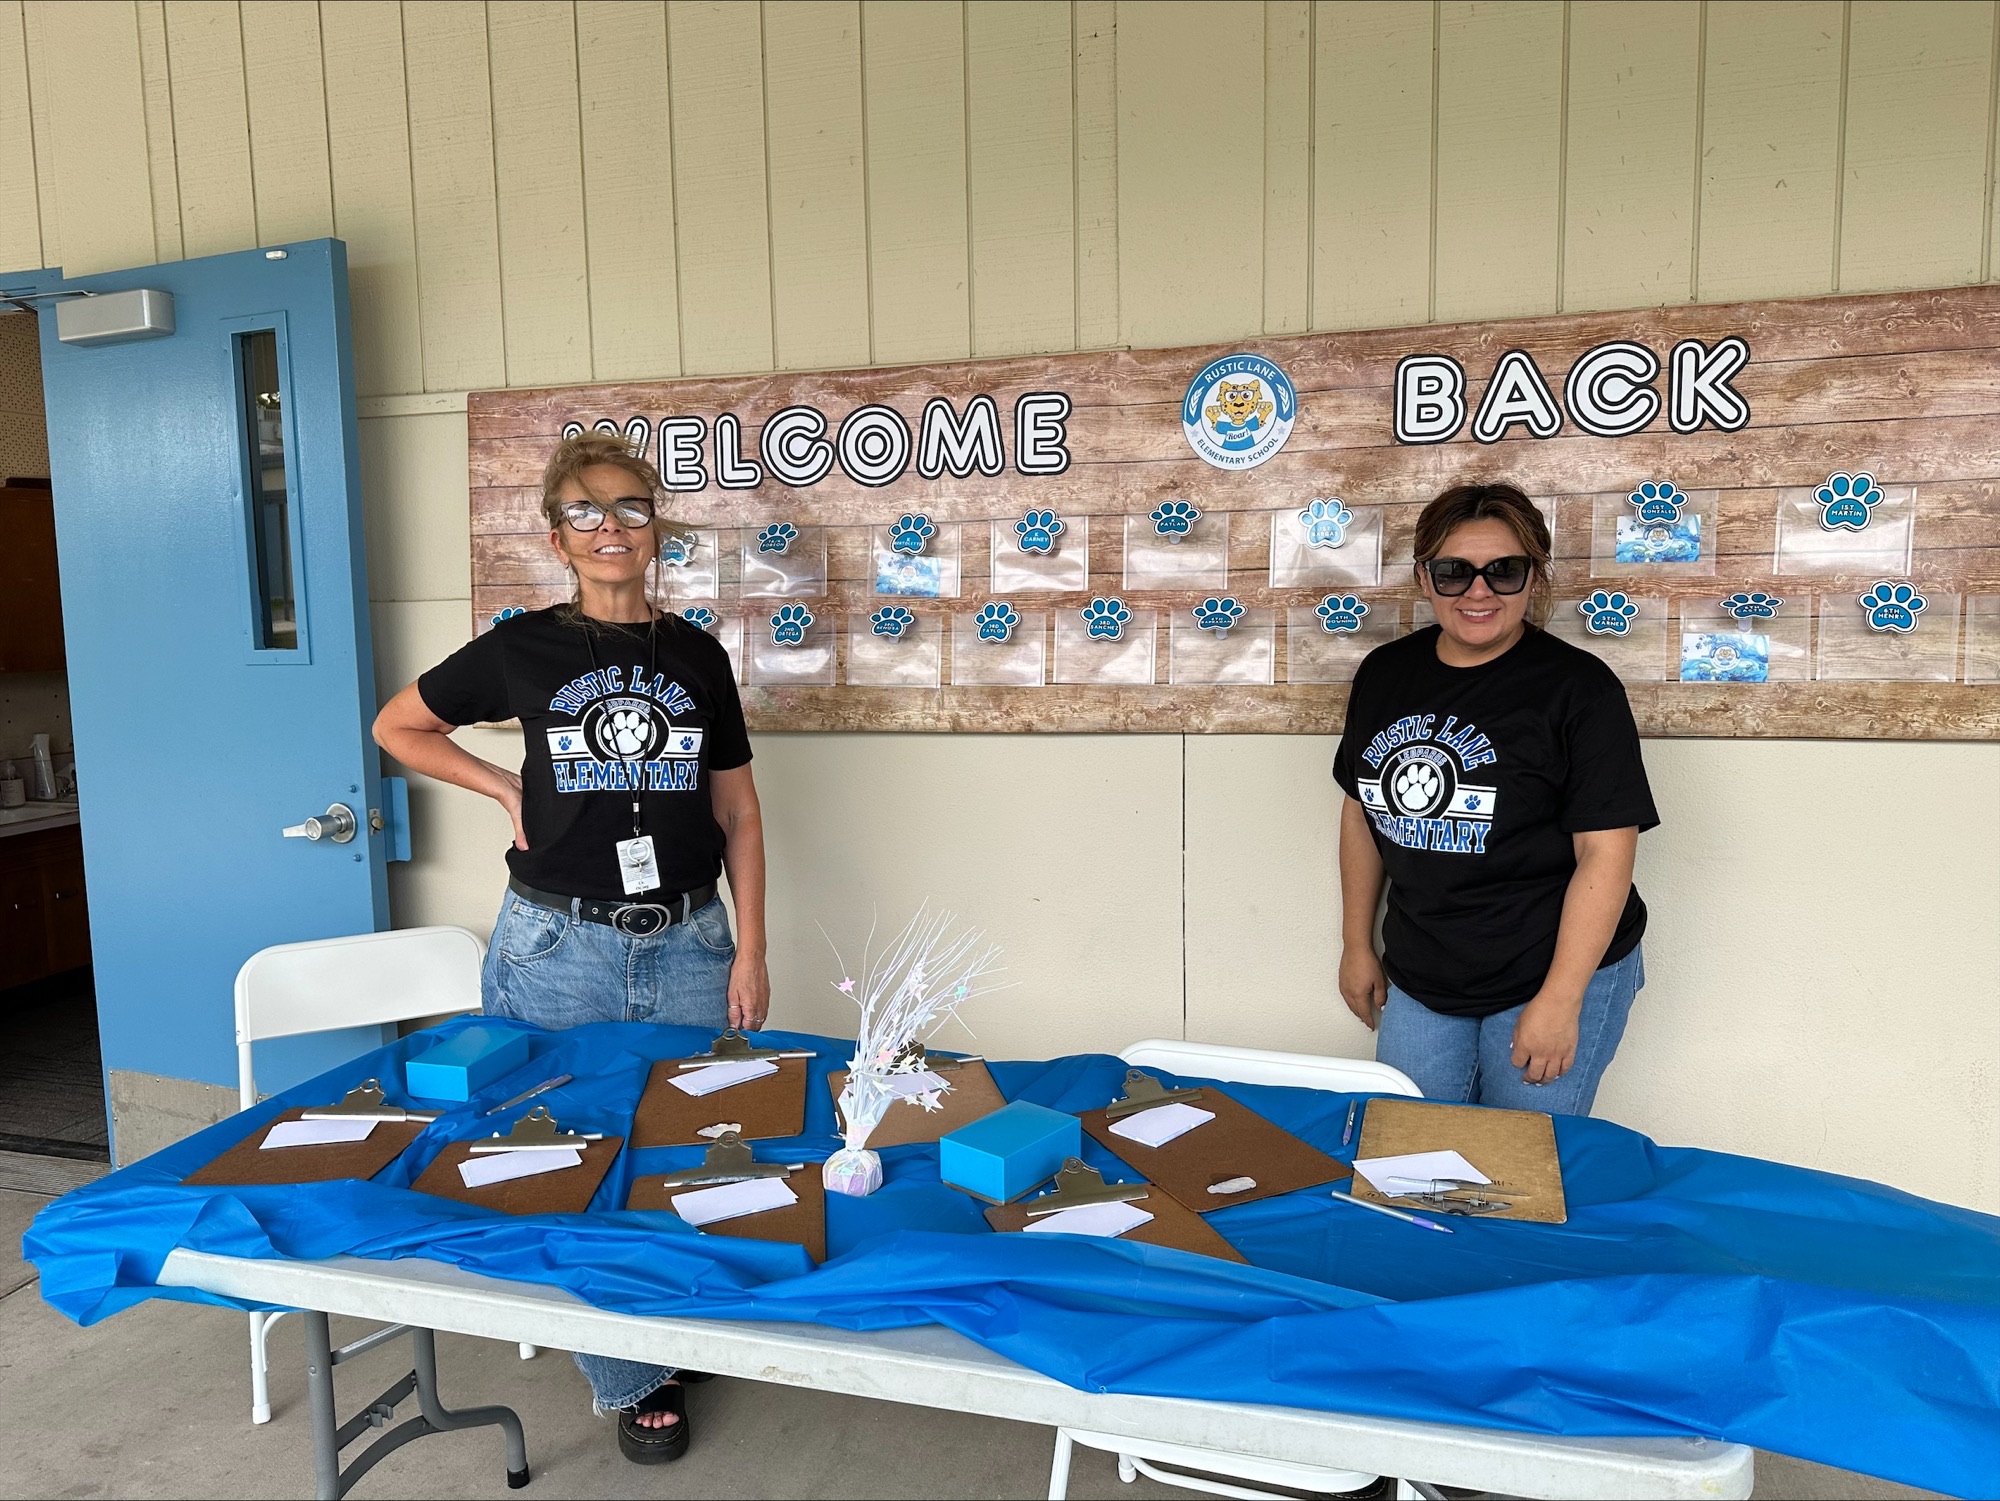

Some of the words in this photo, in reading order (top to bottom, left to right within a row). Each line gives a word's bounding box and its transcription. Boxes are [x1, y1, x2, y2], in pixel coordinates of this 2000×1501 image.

[1204, 361, 1245, 383] RUSTIC
[1247, 361, 1276, 381] LANE
[1393, 335, 1751, 444] BACK
[1196, 438, 1246, 465] ELEMENTARY
[1248, 437, 1279, 462] SCHOOL
[1228, 429, 1250, 441] Roar!
[549, 665, 624, 716] RUSTIC
[629, 665, 696, 716] LANE
[1362, 714, 1436, 770] RUSTIC
[1434, 715, 1497, 772] LANE
[1397, 748, 1448, 767] LEOPARDS
[553, 760, 698, 793] ELEMENTARY
[1366, 808, 1492, 854] EMENTARY
